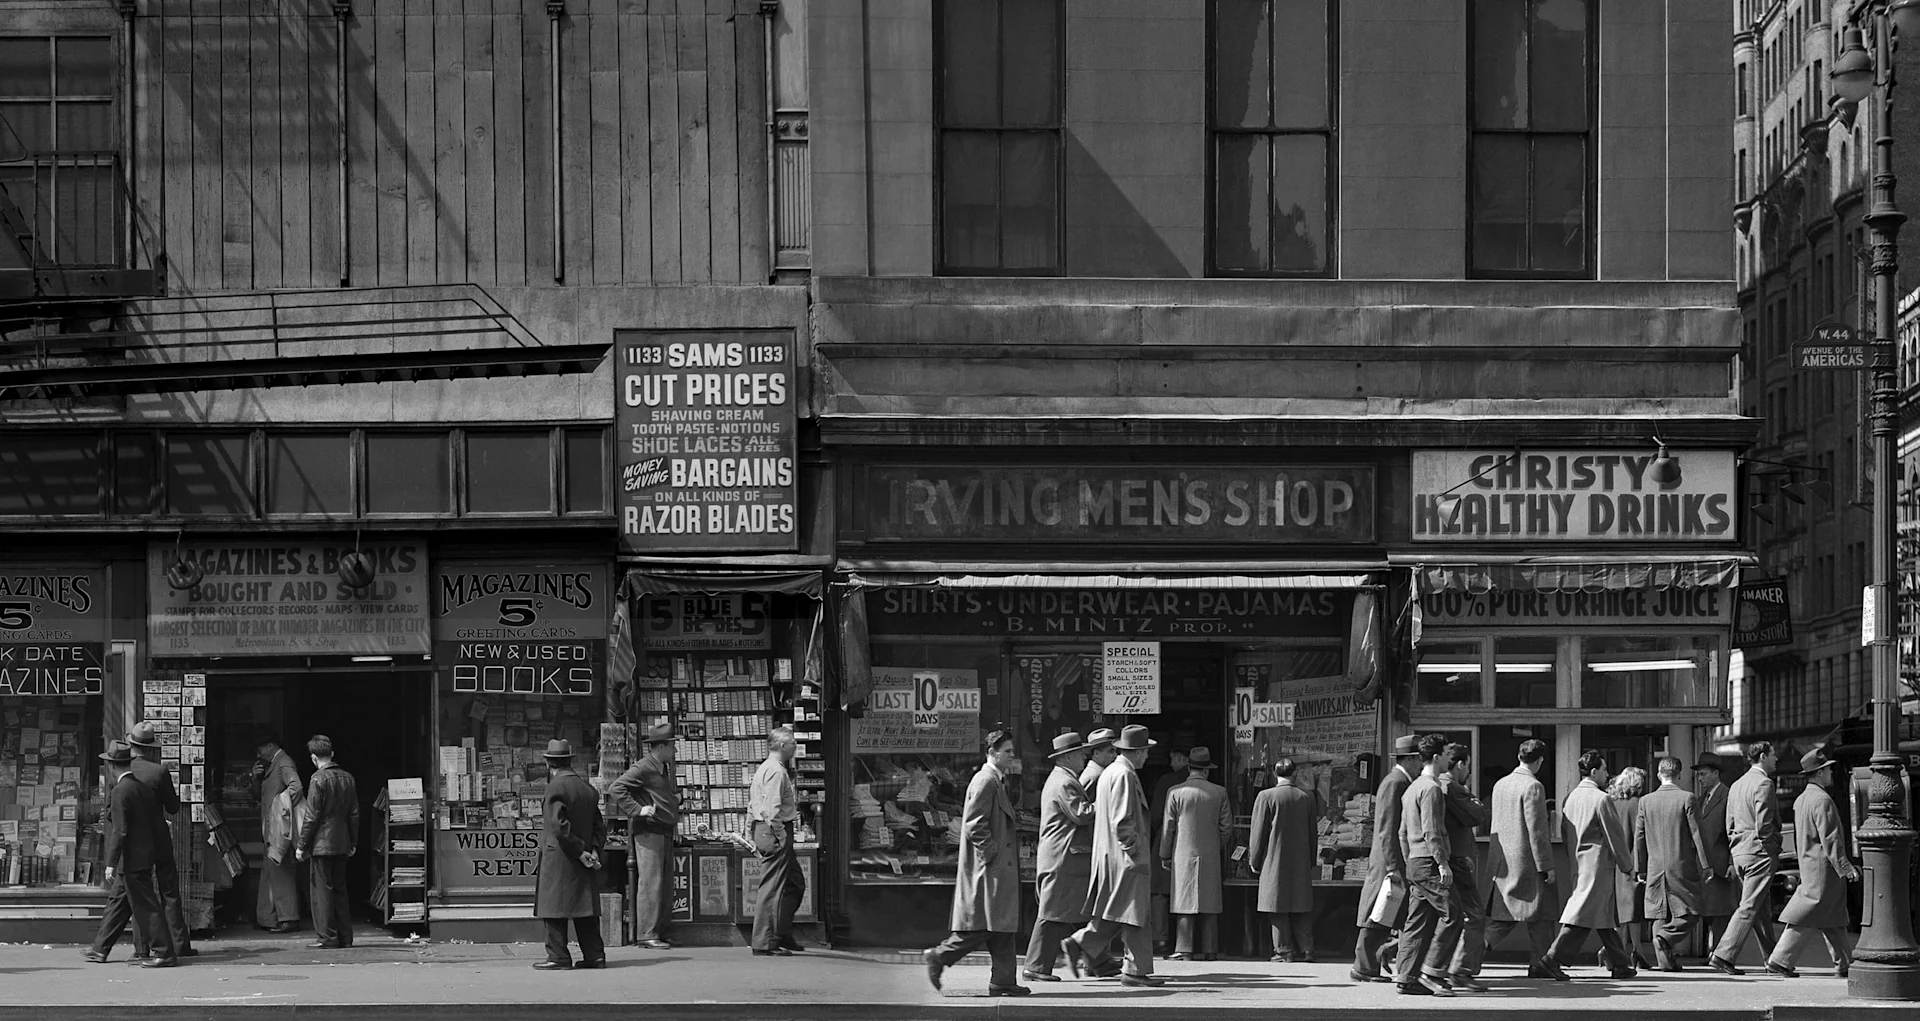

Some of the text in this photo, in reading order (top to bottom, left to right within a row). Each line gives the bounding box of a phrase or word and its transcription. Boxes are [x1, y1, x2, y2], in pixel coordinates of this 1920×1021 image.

[1819, 329, 1850, 340] W. 44
[628, 342, 784, 368] 1133 SAMS 1133
[1802, 346, 1864, 355] AVENUE OF THE
[1802, 354, 1865, 367] AMERICAS
[625, 372, 786, 407] CUT PRICES
[651, 409, 764, 421] SHAVING CREAM
[632, 422, 780, 435] TOOTH PASTE NOTIONS
[632, 435, 742, 454] SHOE LACES
[748, 435, 775, 445] ALL
[744, 444, 781, 453] SIZES
[623, 457, 664, 479] MONEY
[671, 456, 793, 488] BARGAINS
[624, 470, 669, 492] SAVING
[655, 490, 760, 503] ON ALL KINDS OF
[889, 472, 1354, 527] IRVING MEN'S SHOP
[624, 503, 794, 535] RAZOR BLADES
[1588, 494, 1730, 535] DRINKS
[307, 553, 320, 575] &
[323, 546, 416, 575] BKS
[188, 581, 397, 602] BOUGHT AND SOLD
[440, 572, 594, 616] MAGAZINES
[165, 603, 419, 616] STAMPS FOR COLLECTORS RECORDS MAPS VIEW CARDS
[883, 588, 1336, 617] SHIRTS UNDERWEAR PAJAMAS
[1489, 589, 1549, 617] PURE
[1652, 587, 1720, 617] JUICE
[539, 619, 550, 627] UP
[651, 599, 674, 631] 5
[153, 618, 425, 637] LARGEST SELECTION OF BACK NUMBER MAGAZINES IN THE CITY
[456, 627, 577, 639] GREETING CARDS
[683, 617, 741, 633] BLDES
[1007, 617, 1232, 634] B. MINTZ PROP.
[1760, 619, 1789, 641] STORE
[27, 630, 73, 640] CARDS
[170, 637, 190, 649] 1133
[234, 635, 339, 649] Metropolitan Book Shop
[387, 635, 406, 647] 1133
[655, 639, 666, 648] ALL
[666, 639, 684, 648] KINDS
[690, 638, 711, 648] OTHER
[712, 638, 733, 647] BLADES
[739, 638, 765, 647] NOTIONS
[25, 646, 84, 661] DATE
[460, 643, 586, 661] NEW & USED
[1107, 647, 1155, 657] SPECIAL
[453, 664, 593, 695] BOOKS
[875, 692, 911, 709] LAST
[914, 677, 938, 711] 10
[945, 692, 978, 709] SALE
[1236, 693, 1251, 726] 10
[1260, 707, 1292, 723] SALE
[1294, 695, 1352, 719] ANNIVERSARY
[915, 713, 938, 725] DAYS
[1236, 730, 1252, 739] DAYS
[505, 850, 537, 858] AND
[701, 875, 712, 886] 3
